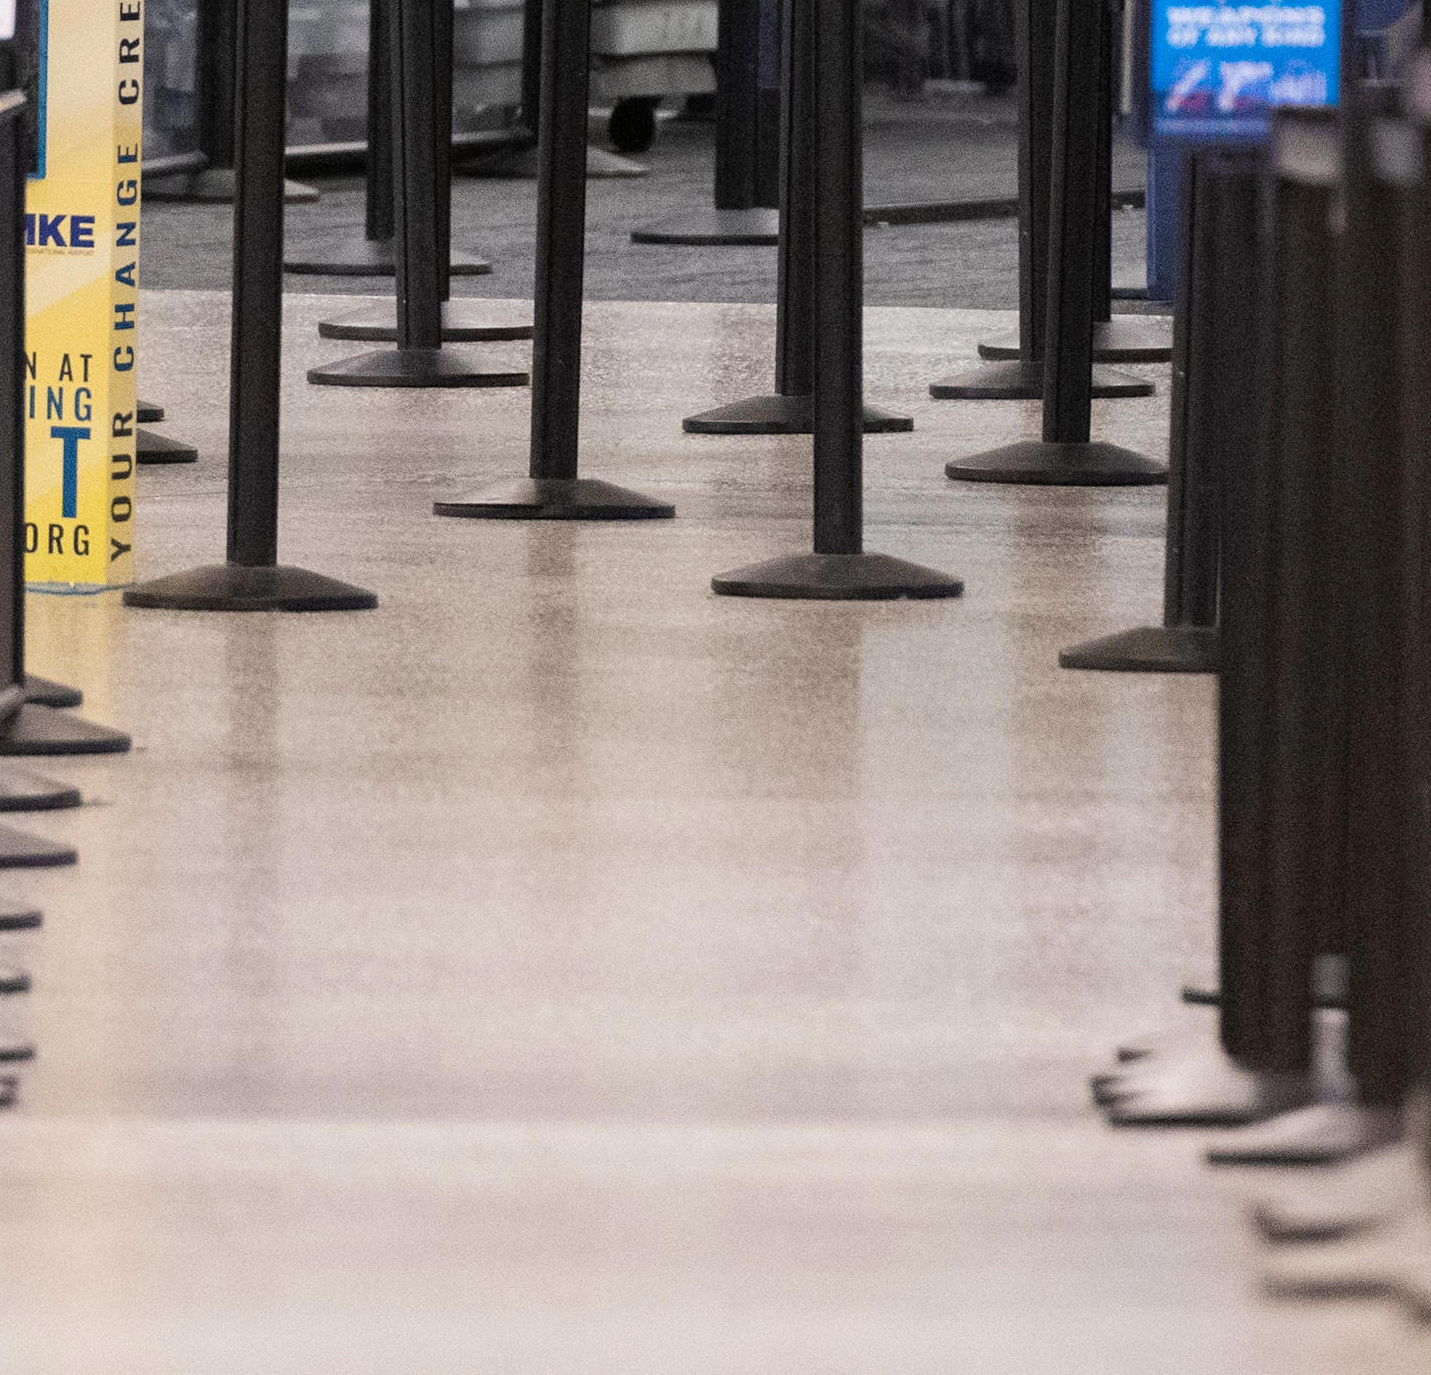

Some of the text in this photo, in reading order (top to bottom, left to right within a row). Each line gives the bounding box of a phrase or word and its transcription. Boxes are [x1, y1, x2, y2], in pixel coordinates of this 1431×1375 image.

[59, 353, 92, 383] AT
[110, 143, 140, 562] YOUR CHANGE
[25, 522, 90, 557] ORG
